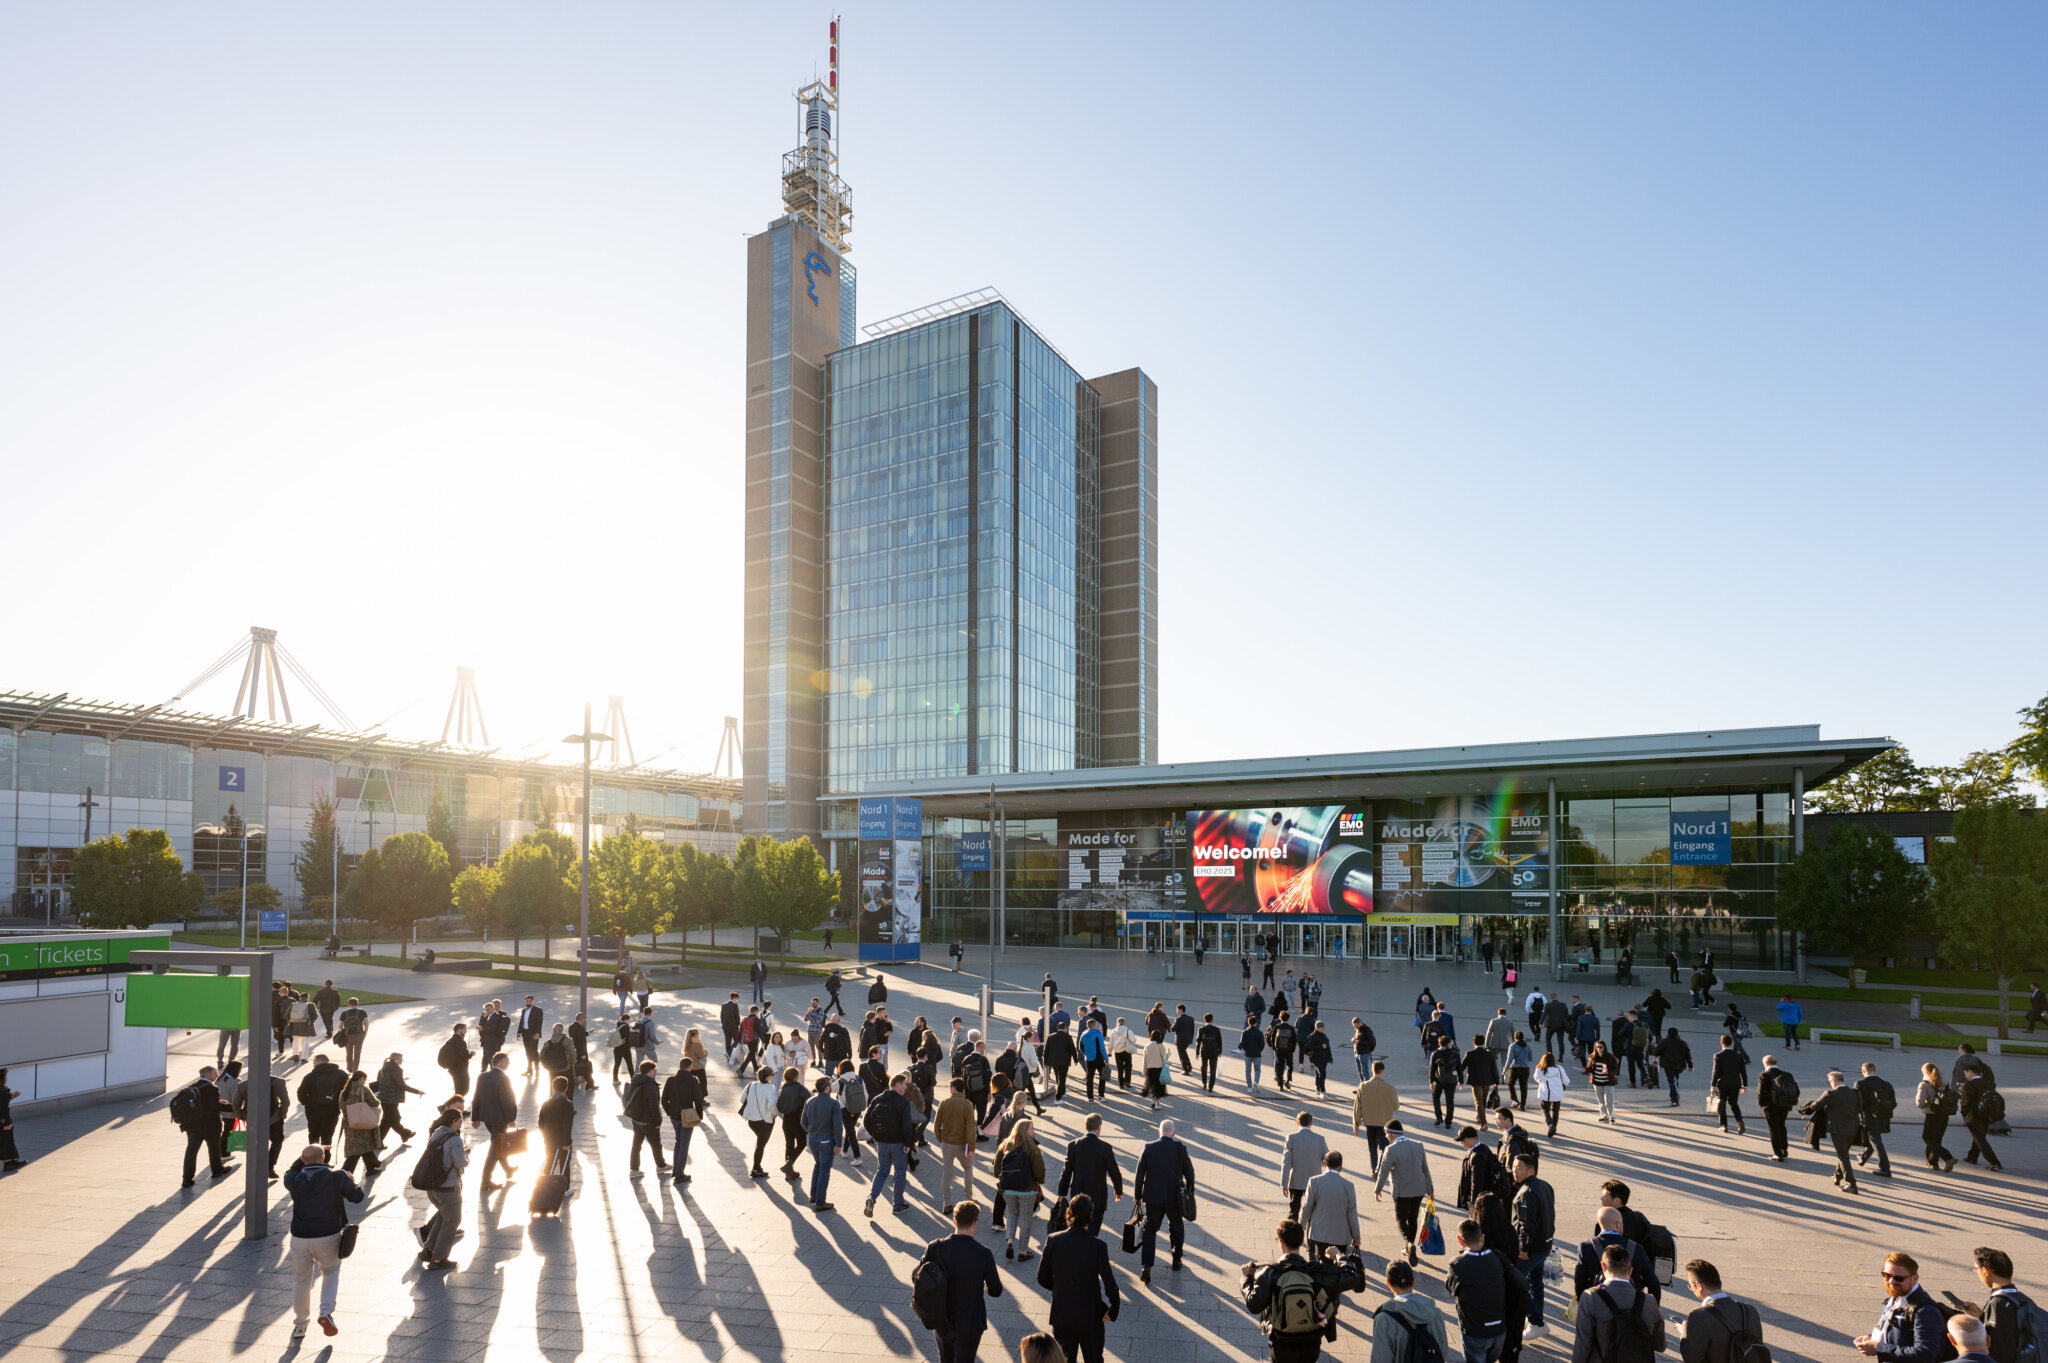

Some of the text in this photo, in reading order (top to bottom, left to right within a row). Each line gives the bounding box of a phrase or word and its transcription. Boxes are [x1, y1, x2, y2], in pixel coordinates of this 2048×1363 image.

[227, 772, 238, 786] 2
[860, 804, 888, 815] Nord 1
[896, 804, 918, 815] Nord 1
[860, 820, 886, 830] Eingang
[896, 820, 917, 830] Eingang
[1340, 820, 1363, 829] EMO
[1511, 816, 1541, 827] EMO
[860, 829, 888, 837] Entrance
[1381, 823, 1472, 838] Made for
[1673, 821, 1728, 835] Nord 1
[1069, 831, 1136, 845] Made for
[962, 840, 985, 850] Nord
[986, 840, 991, 849] 1
[1673, 841, 1715, 852] Eingang
[962, 853, 985, 861] Eingang
[1194, 844, 1288, 860] Welcome!
[1673, 852, 1719, 861] Entrance
[1213, 867, 1233, 875] 2025
[1149, 911, 1172, 919] Entranc
[1226, 912, 1253, 921] Eingang
[1306, 913, 1338, 921] Entrance
[1380, 915, 1411, 923] Aussteller
[34, 946, 103, 964] Tickets
